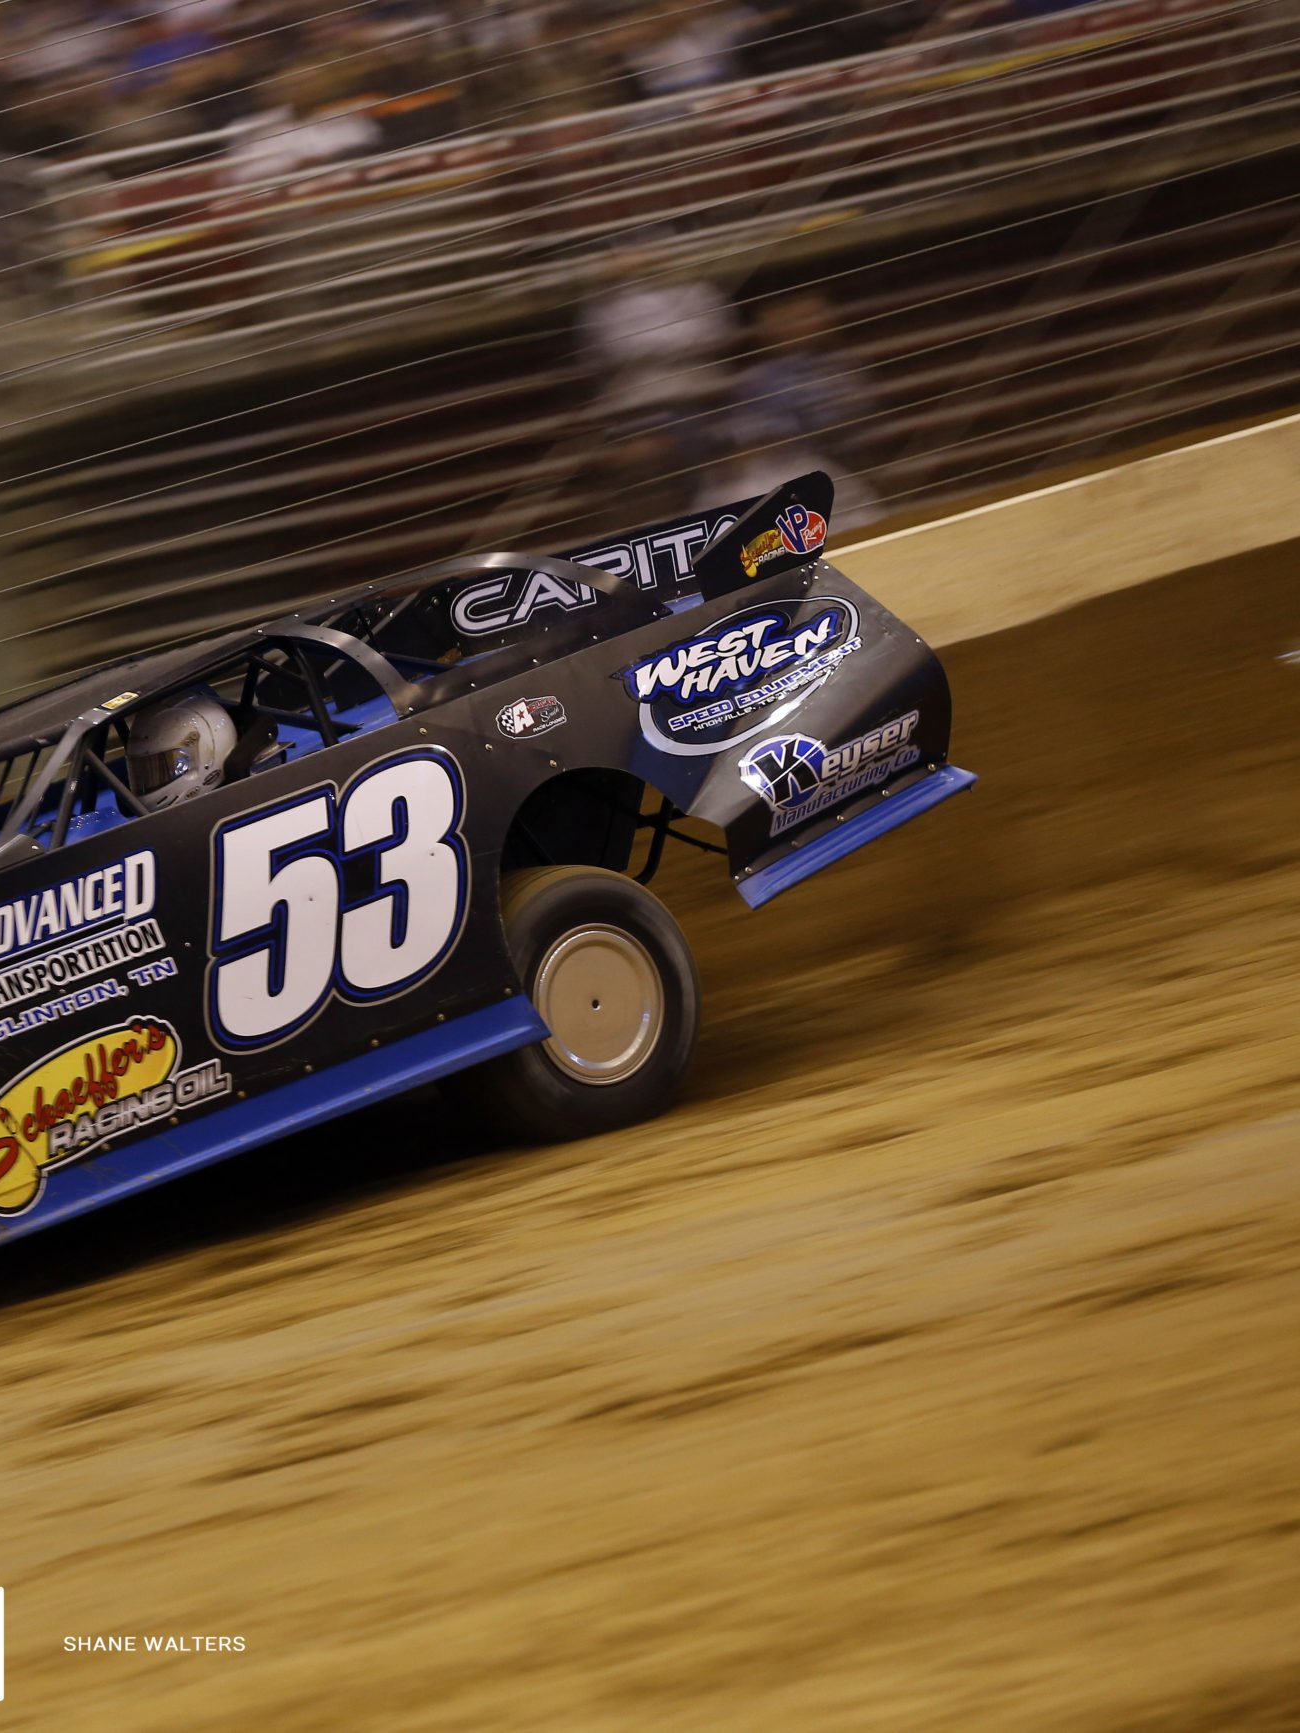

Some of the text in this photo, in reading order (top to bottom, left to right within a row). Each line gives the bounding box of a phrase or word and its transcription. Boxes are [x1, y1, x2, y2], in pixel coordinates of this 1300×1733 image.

[775, 504, 809, 554] VP
[635, 619, 778, 698] WEST
[669, 637, 863, 731] SPEED EQUIPMENT
[681, 617, 832, 699] HAVEN
[752, 710, 918, 807] Keyser
[773, 749, 918, 831] Manufacturing Co.
[213, 755, 465, 1043] 53
[129, 958, 177, 986] TN
[50, 1062, 230, 1154] RACING OIL
